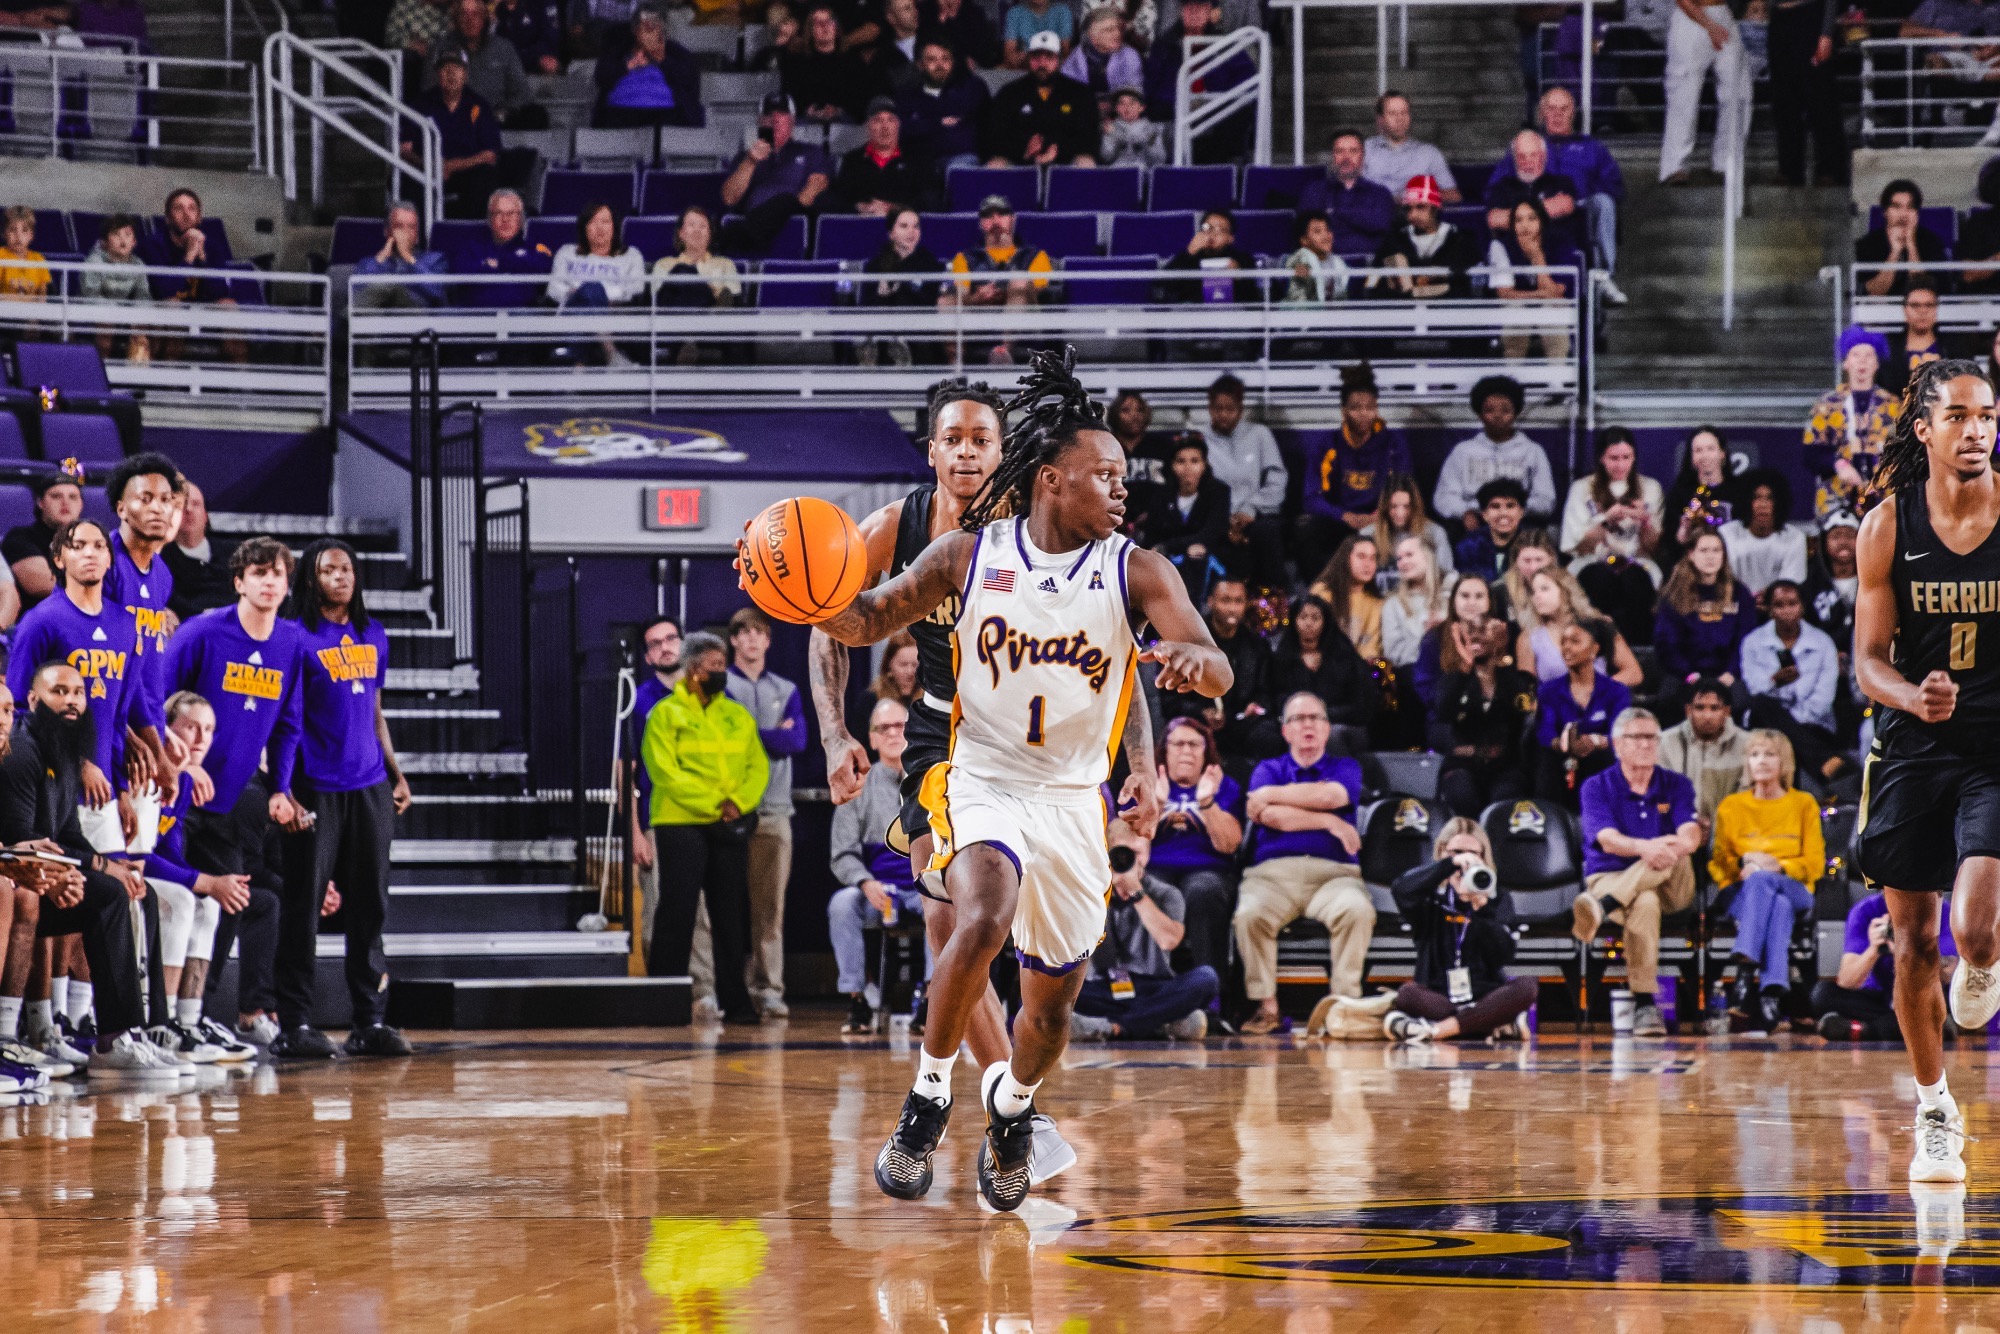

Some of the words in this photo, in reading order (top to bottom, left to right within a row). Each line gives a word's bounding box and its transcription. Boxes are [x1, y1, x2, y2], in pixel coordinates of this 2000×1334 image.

[658, 488, 701, 525] EXIT
[766, 503, 791, 581] Wilson
[1037, 585, 1059, 594] adidas
[1910, 580, 2000, 614] FERRU
[125, 605, 168, 637] PM
[977, 615, 1112, 695] Pirates
[1950, 621, 1978, 671] 0
[66, 648, 127, 681] GPM
[225, 661, 285, 686] PIRATE
[328, 662, 378, 683] PIRATES
[1026, 695, 1046, 747] 1
